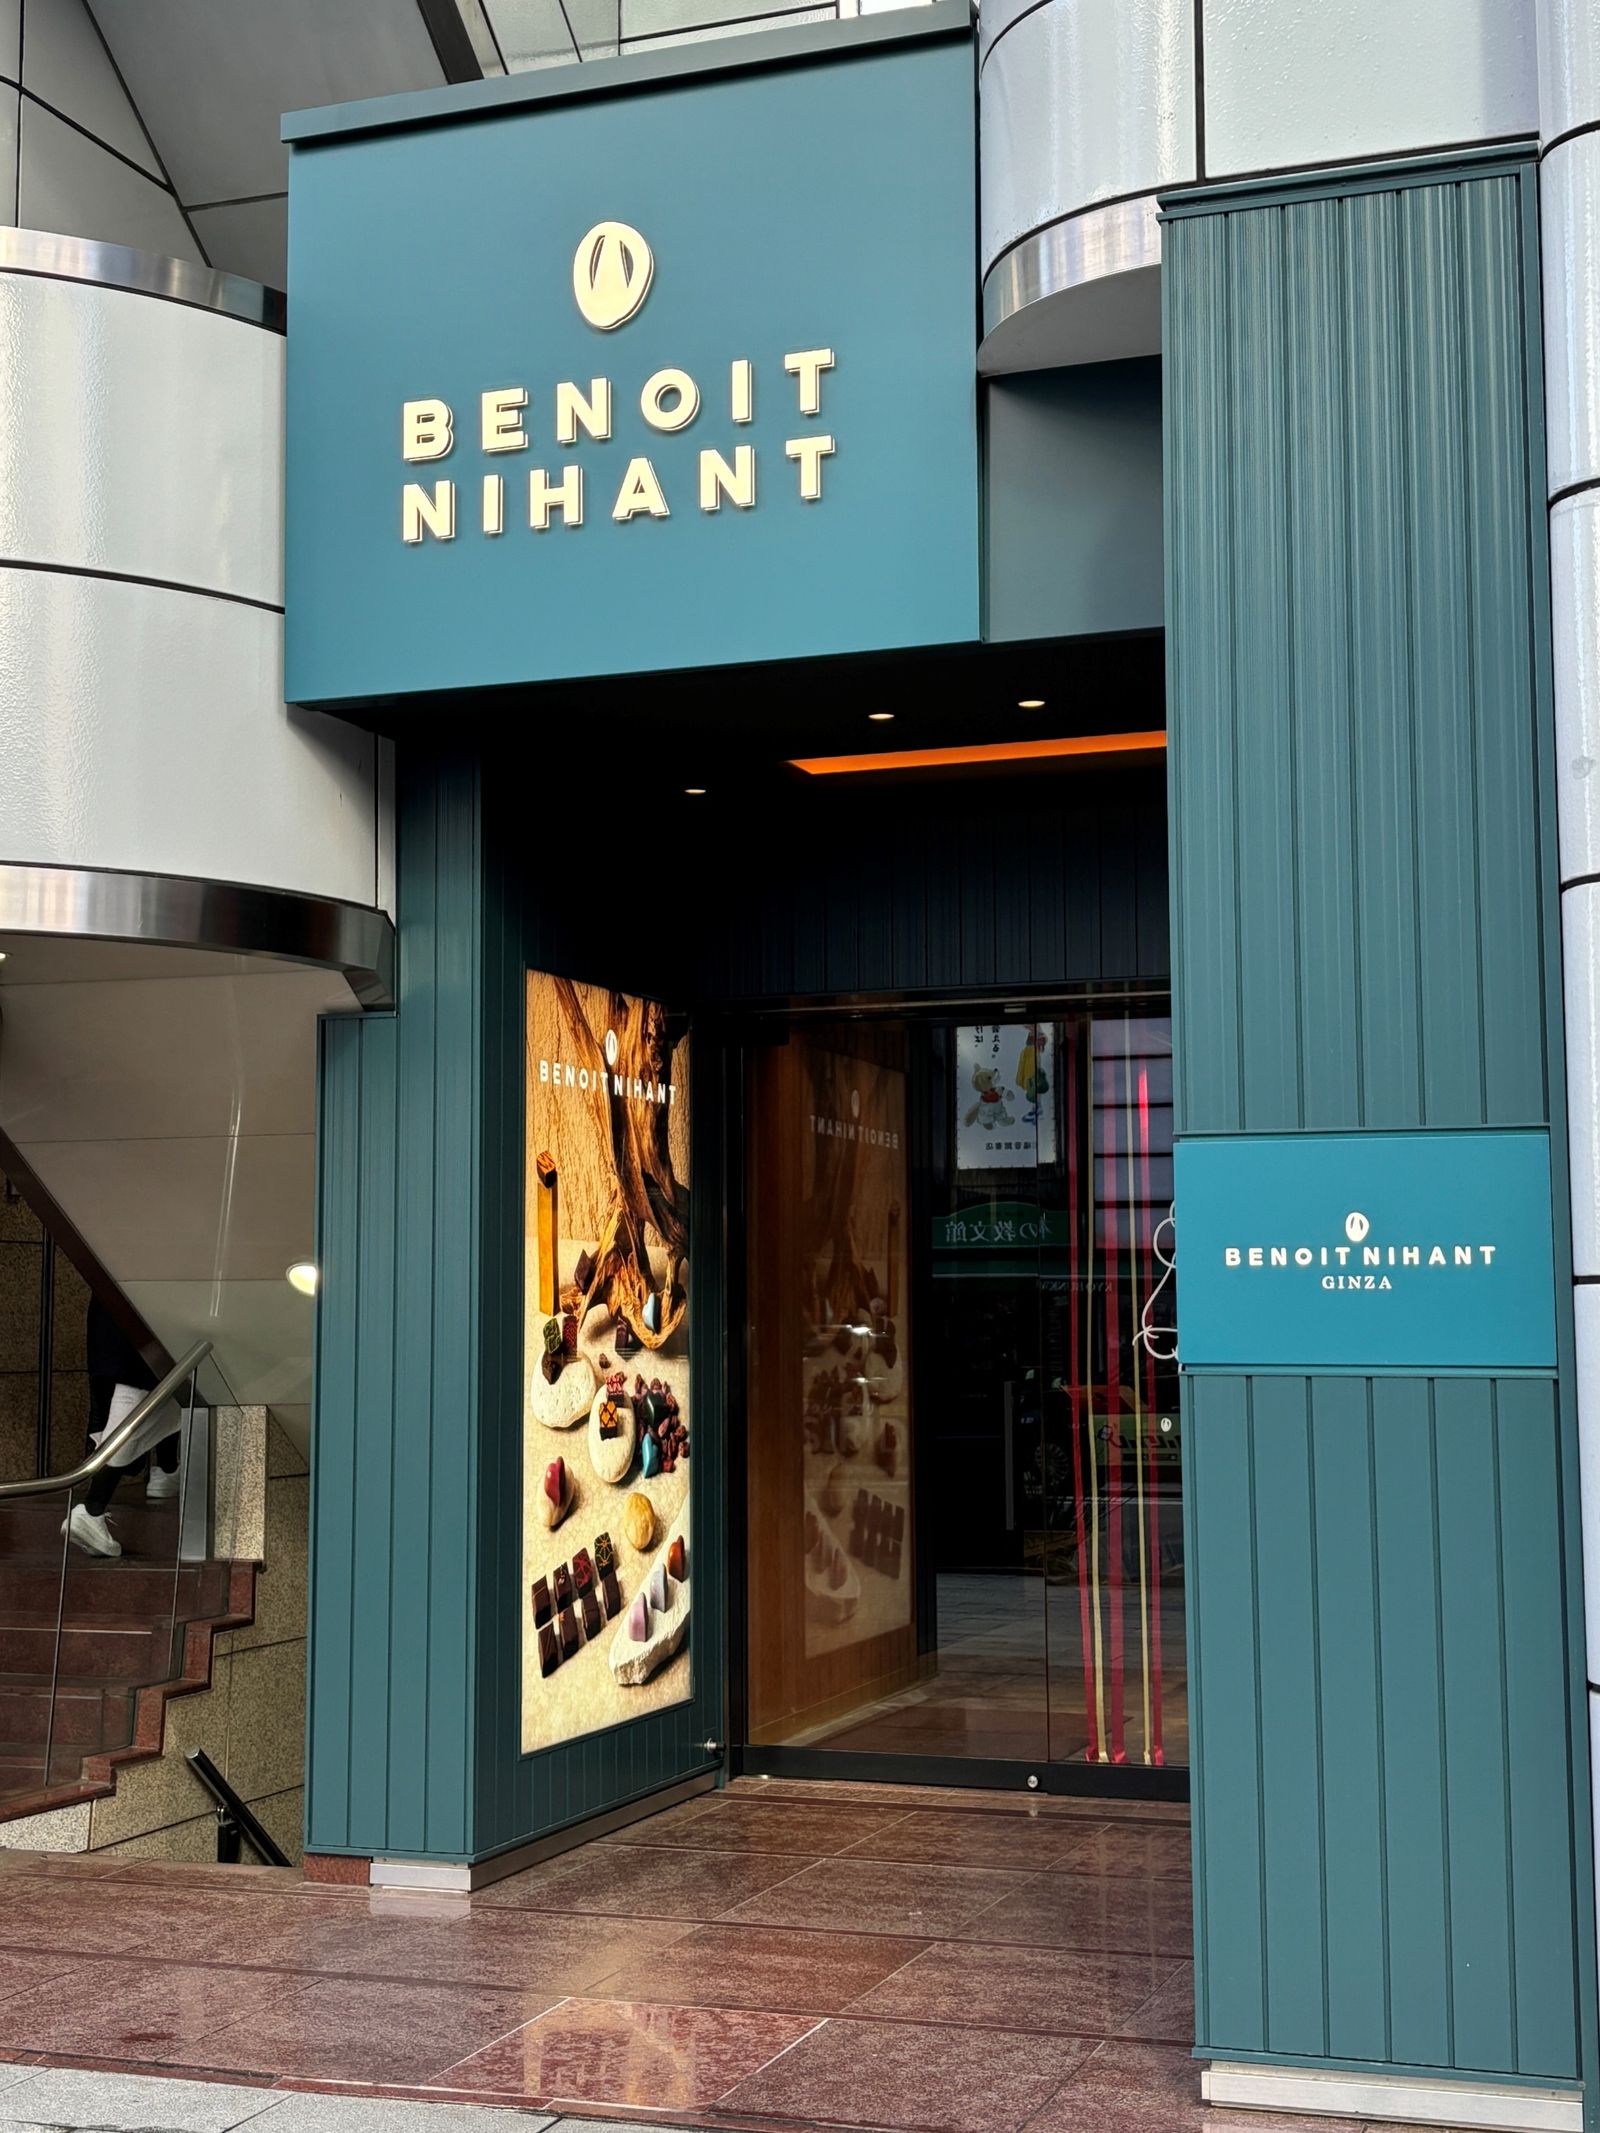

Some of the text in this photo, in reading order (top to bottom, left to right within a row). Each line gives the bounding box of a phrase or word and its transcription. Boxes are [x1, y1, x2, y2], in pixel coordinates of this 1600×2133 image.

[402, 347, 836, 463] BENOIT
[402, 434, 836, 543] NIHANT
[539, 1059, 677, 1105] BENOIT NIHANT
[1224, 1245, 1497, 1267] BENOIT NIHANT
[1321, 1275, 1393, 1290] GINZA
